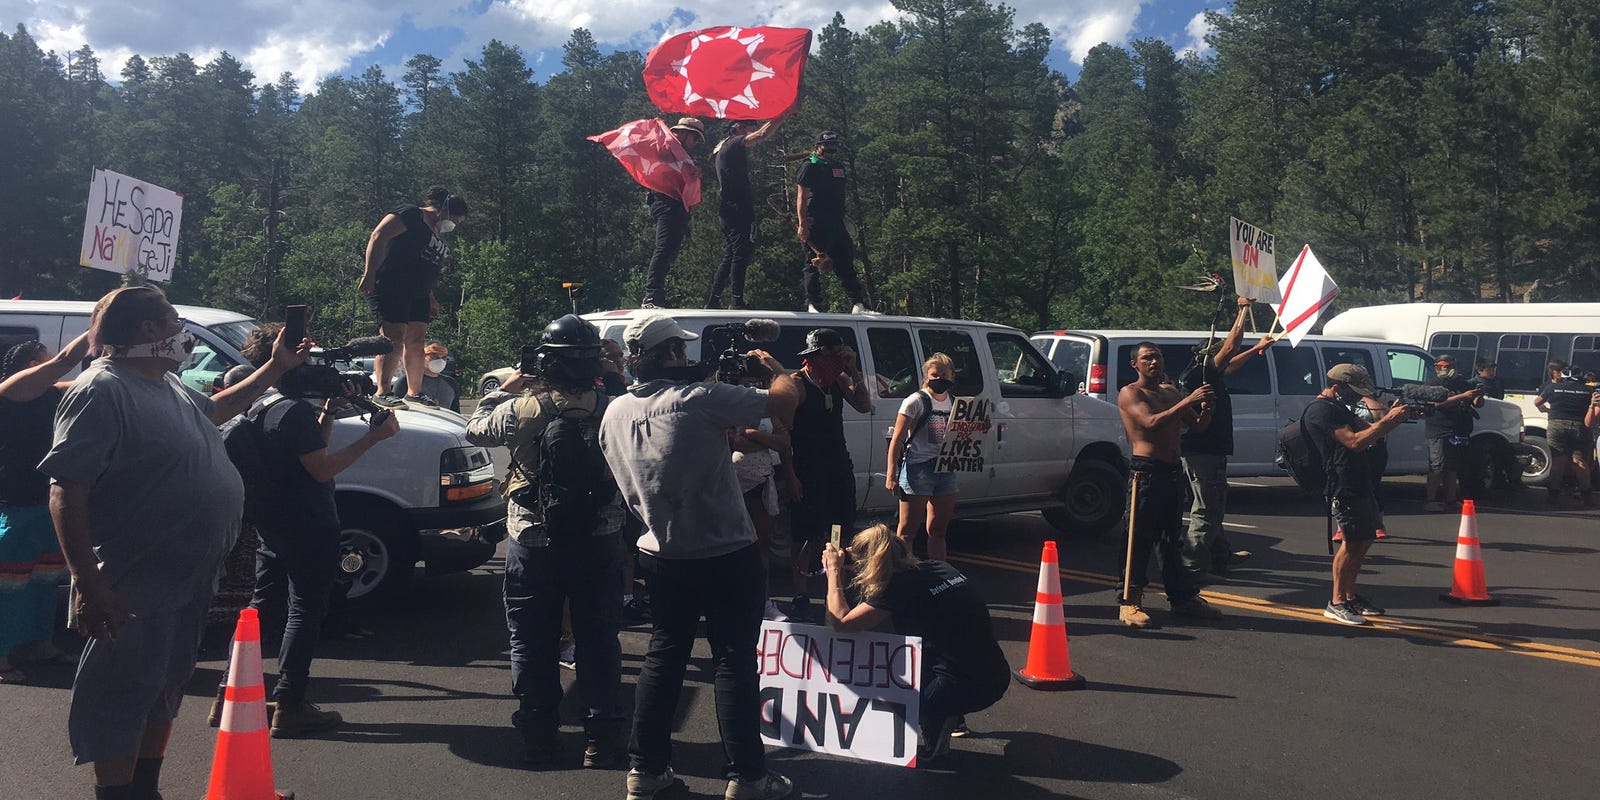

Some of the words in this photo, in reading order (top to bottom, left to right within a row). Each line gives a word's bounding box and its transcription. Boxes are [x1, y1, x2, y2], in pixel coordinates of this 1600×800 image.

[100, 177, 127, 229] HE
[128, 186, 174, 245] Sapa
[1235, 220, 1255, 246] YOU
[1255, 230, 1273, 255] ARE
[1243, 243, 1259, 269] ON
[940, 439, 982, 458] LIVES
[936, 456, 985, 473] MATTER
[760, 686, 907, 759] LAND
